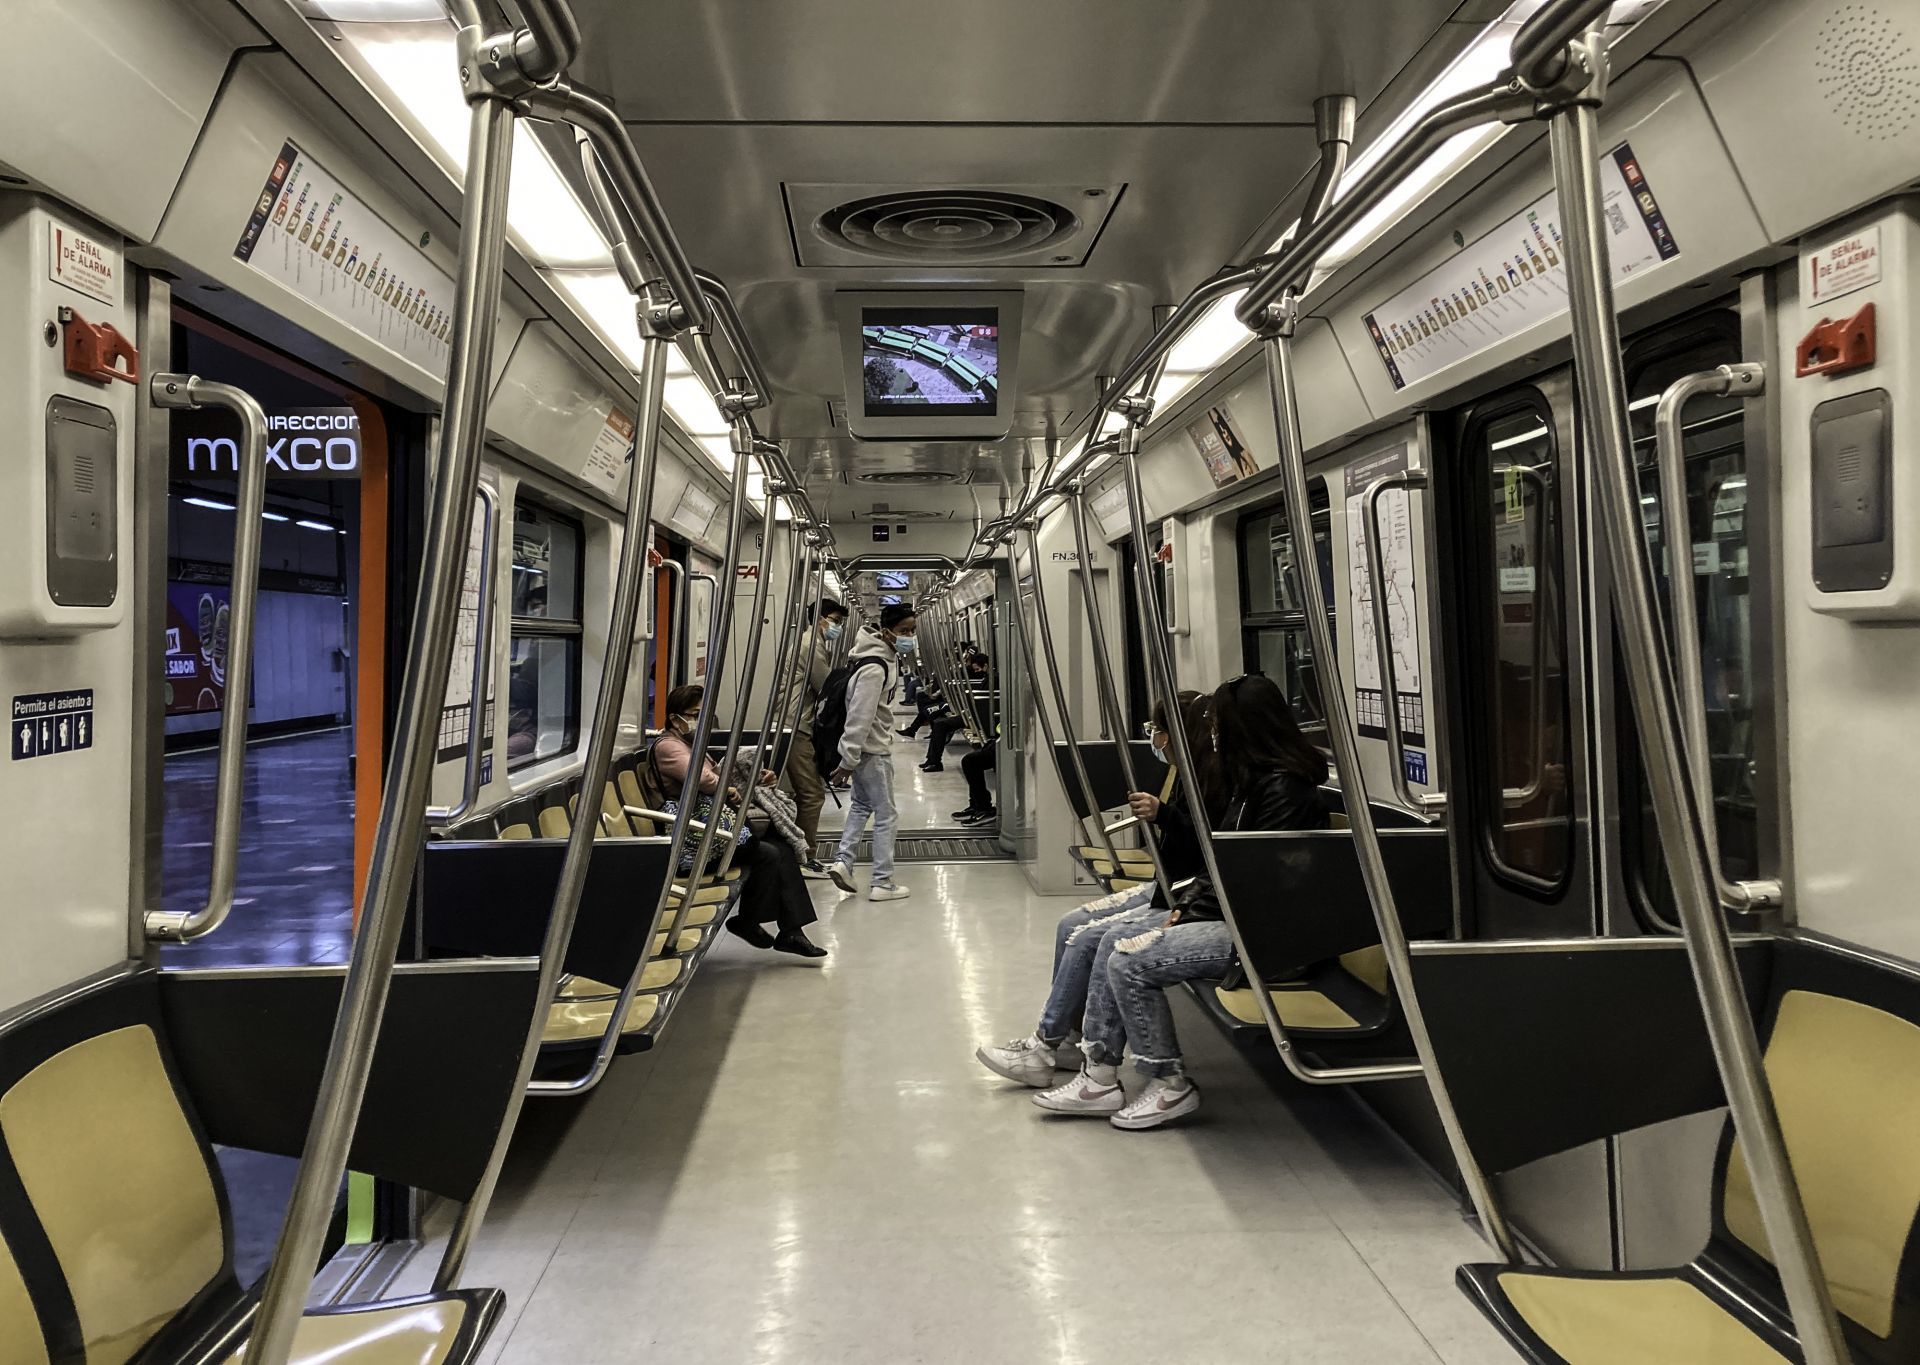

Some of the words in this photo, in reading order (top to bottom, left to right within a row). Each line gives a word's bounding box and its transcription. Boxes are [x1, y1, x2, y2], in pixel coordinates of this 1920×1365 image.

[75, 238, 102, 260] SEÑAL
[1831, 240, 1863, 260] SEÑAL
[64, 247, 76, 261] DE
[78, 254, 112, 279] ALARMA
[1820, 263, 1832, 278] DE
[1835, 247, 1876, 271] ALARMA
[169, 660, 195, 674] SABOR
[14, 699, 47, 715] Permita
[48, 697, 56, 711] el
[57, 695, 85, 710] asiento
[86, 696, 92, 707] a
